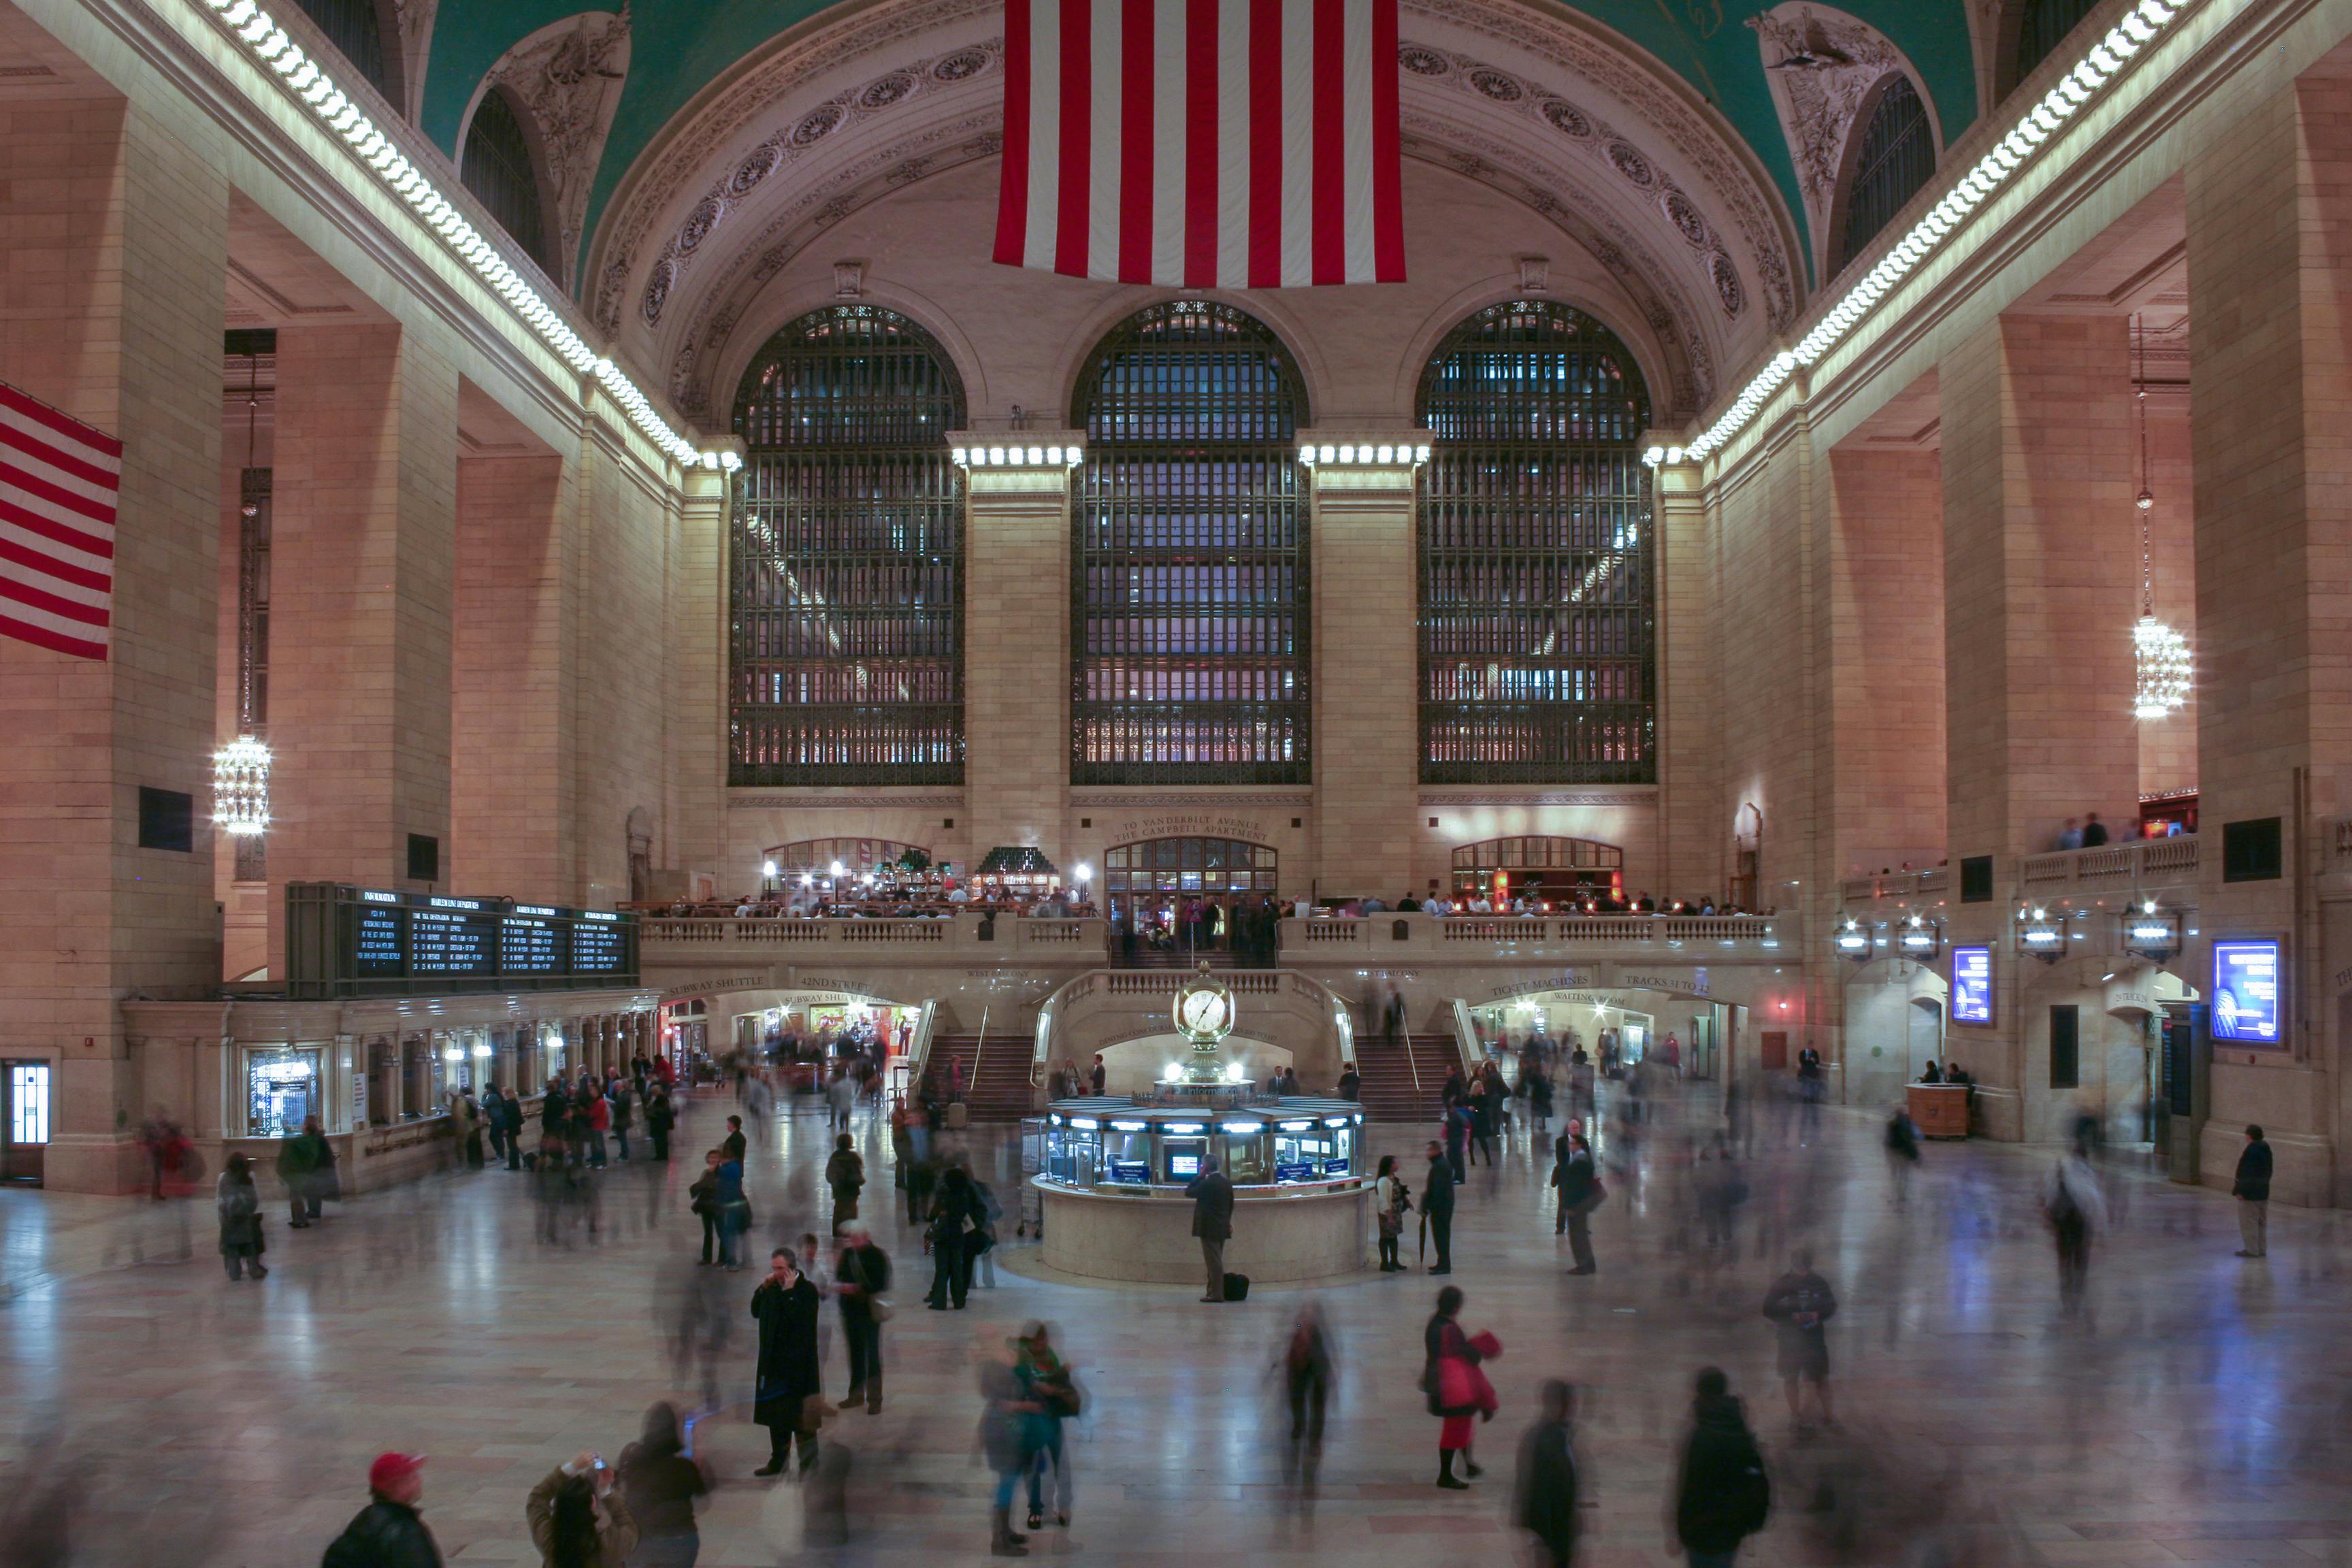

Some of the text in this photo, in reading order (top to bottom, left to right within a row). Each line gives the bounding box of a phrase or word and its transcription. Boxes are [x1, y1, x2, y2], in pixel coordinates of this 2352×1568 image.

[1123, 816, 1260, 830] TO VANDERBILT AVENUE
[1115, 826, 1268, 842] THE CAMPBELL APARTMENT
[670, 977, 764, 996] SUBWAY SHUTTLE
[801, 977, 871, 992] 42ND STREET
[1491, 975, 1588, 996] TICKET MACHINES
[1626, 975, 1667, 987] TRACKS
[1668, 979, 1678, 988] 31
[1682, 981, 1696, 991] TO
[785, 994, 822, 1005] SUBWAY
[1554, 992, 1626, 1007] WAITING ROOM
[1099, 1024, 1173, 1045] DINING CONCOURSE
[1188, 1085, 1237, 1096] Information
